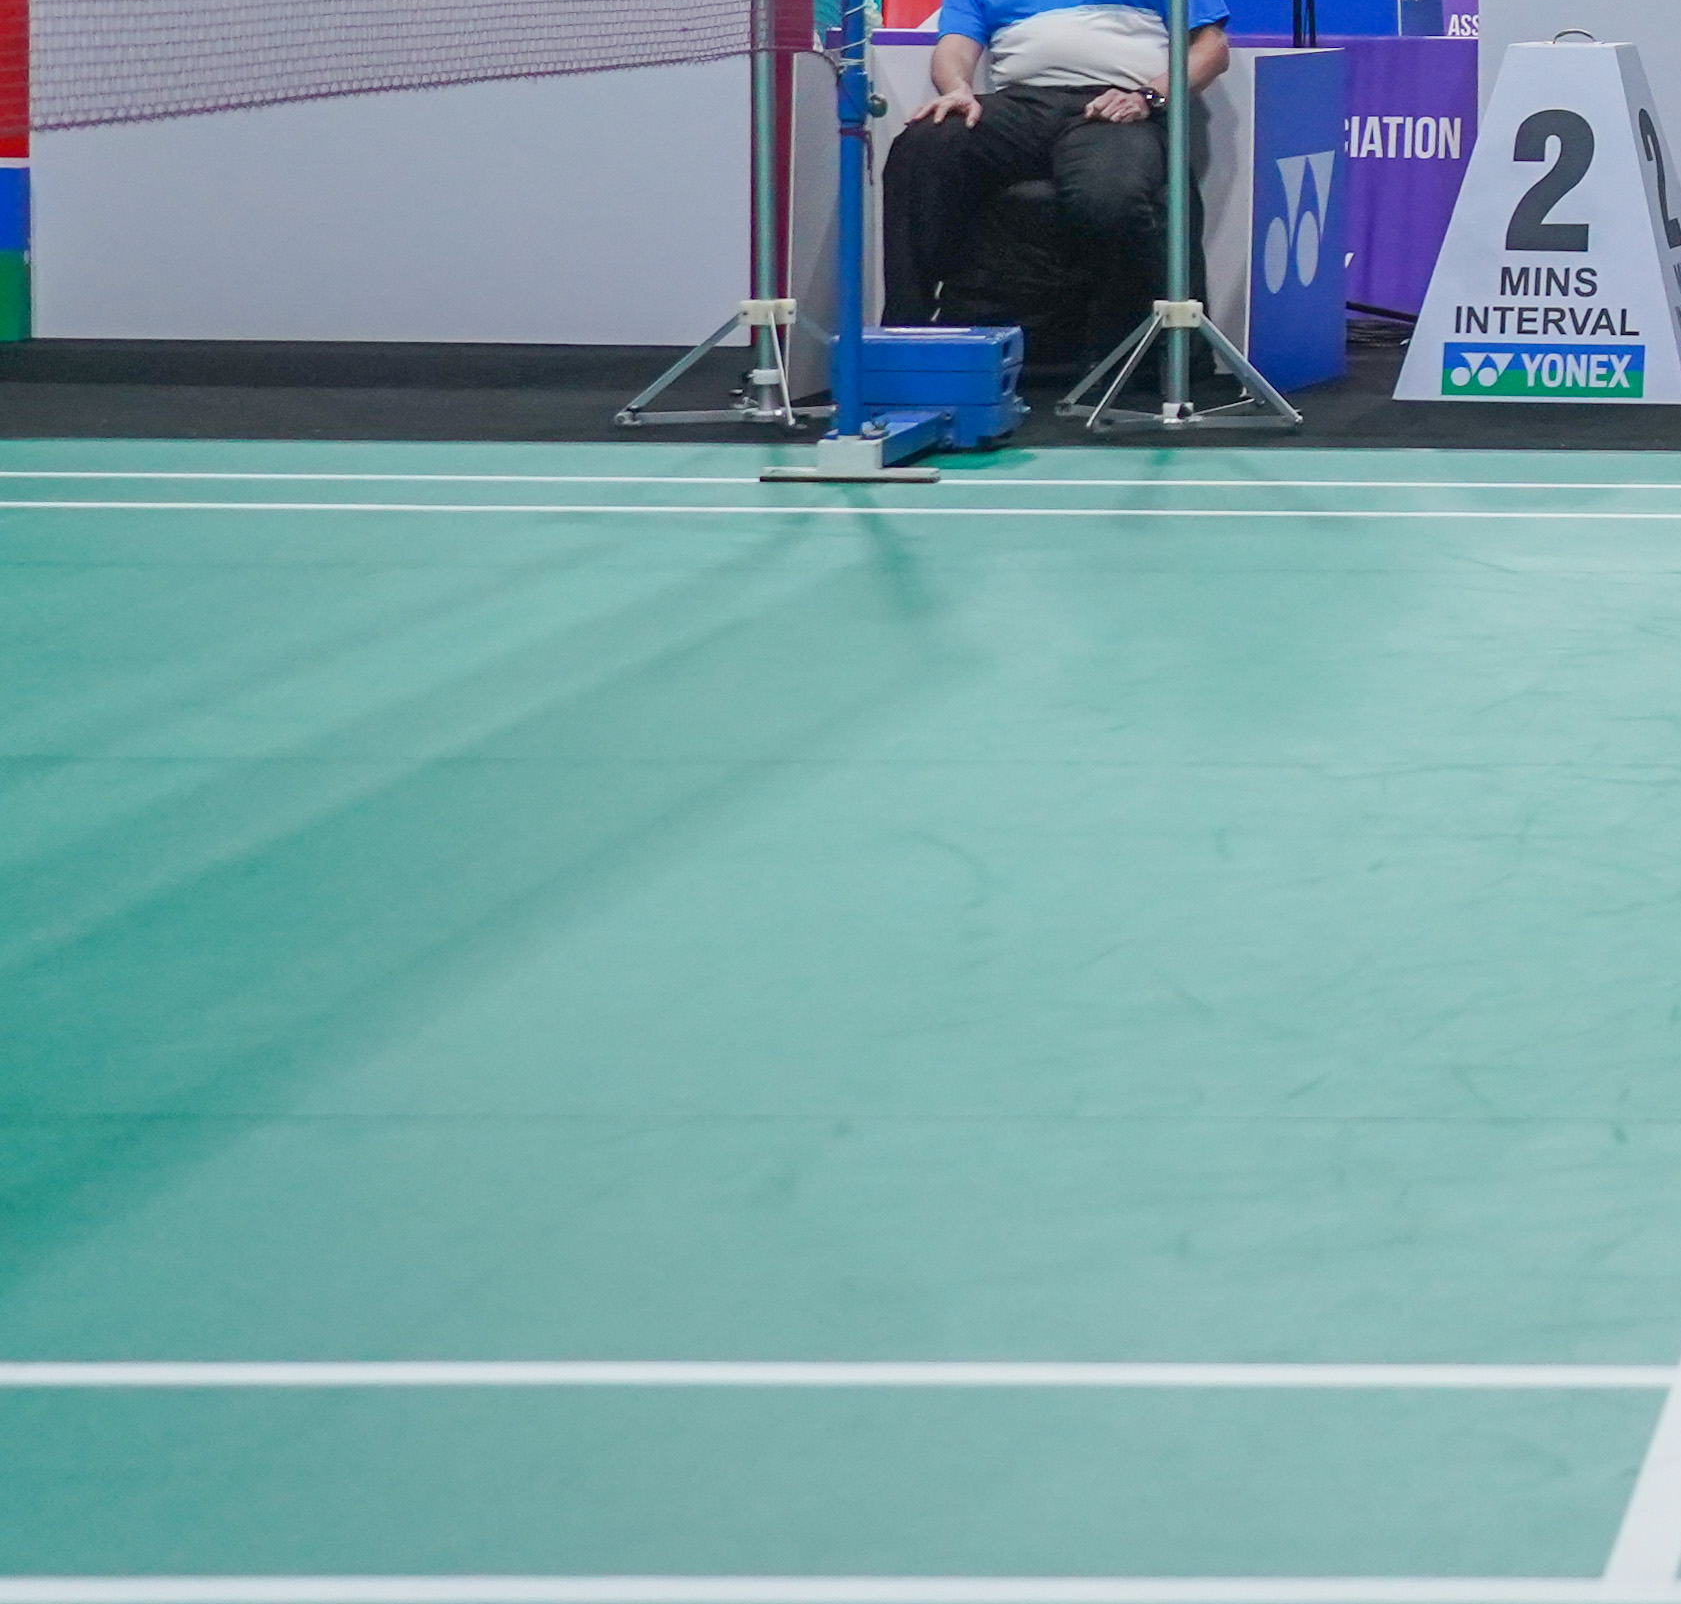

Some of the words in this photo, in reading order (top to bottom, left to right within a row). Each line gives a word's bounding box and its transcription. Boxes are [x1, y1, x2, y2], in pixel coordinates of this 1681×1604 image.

[1345, 116, 1463, 160] IATION
[1505, 108, 1596, 252] 2
[1499, 266, 1598, 298] MINS
[1454, 304, 1641, 338] INTERVAL
[1521, 355, 1633, 389] YONEX
